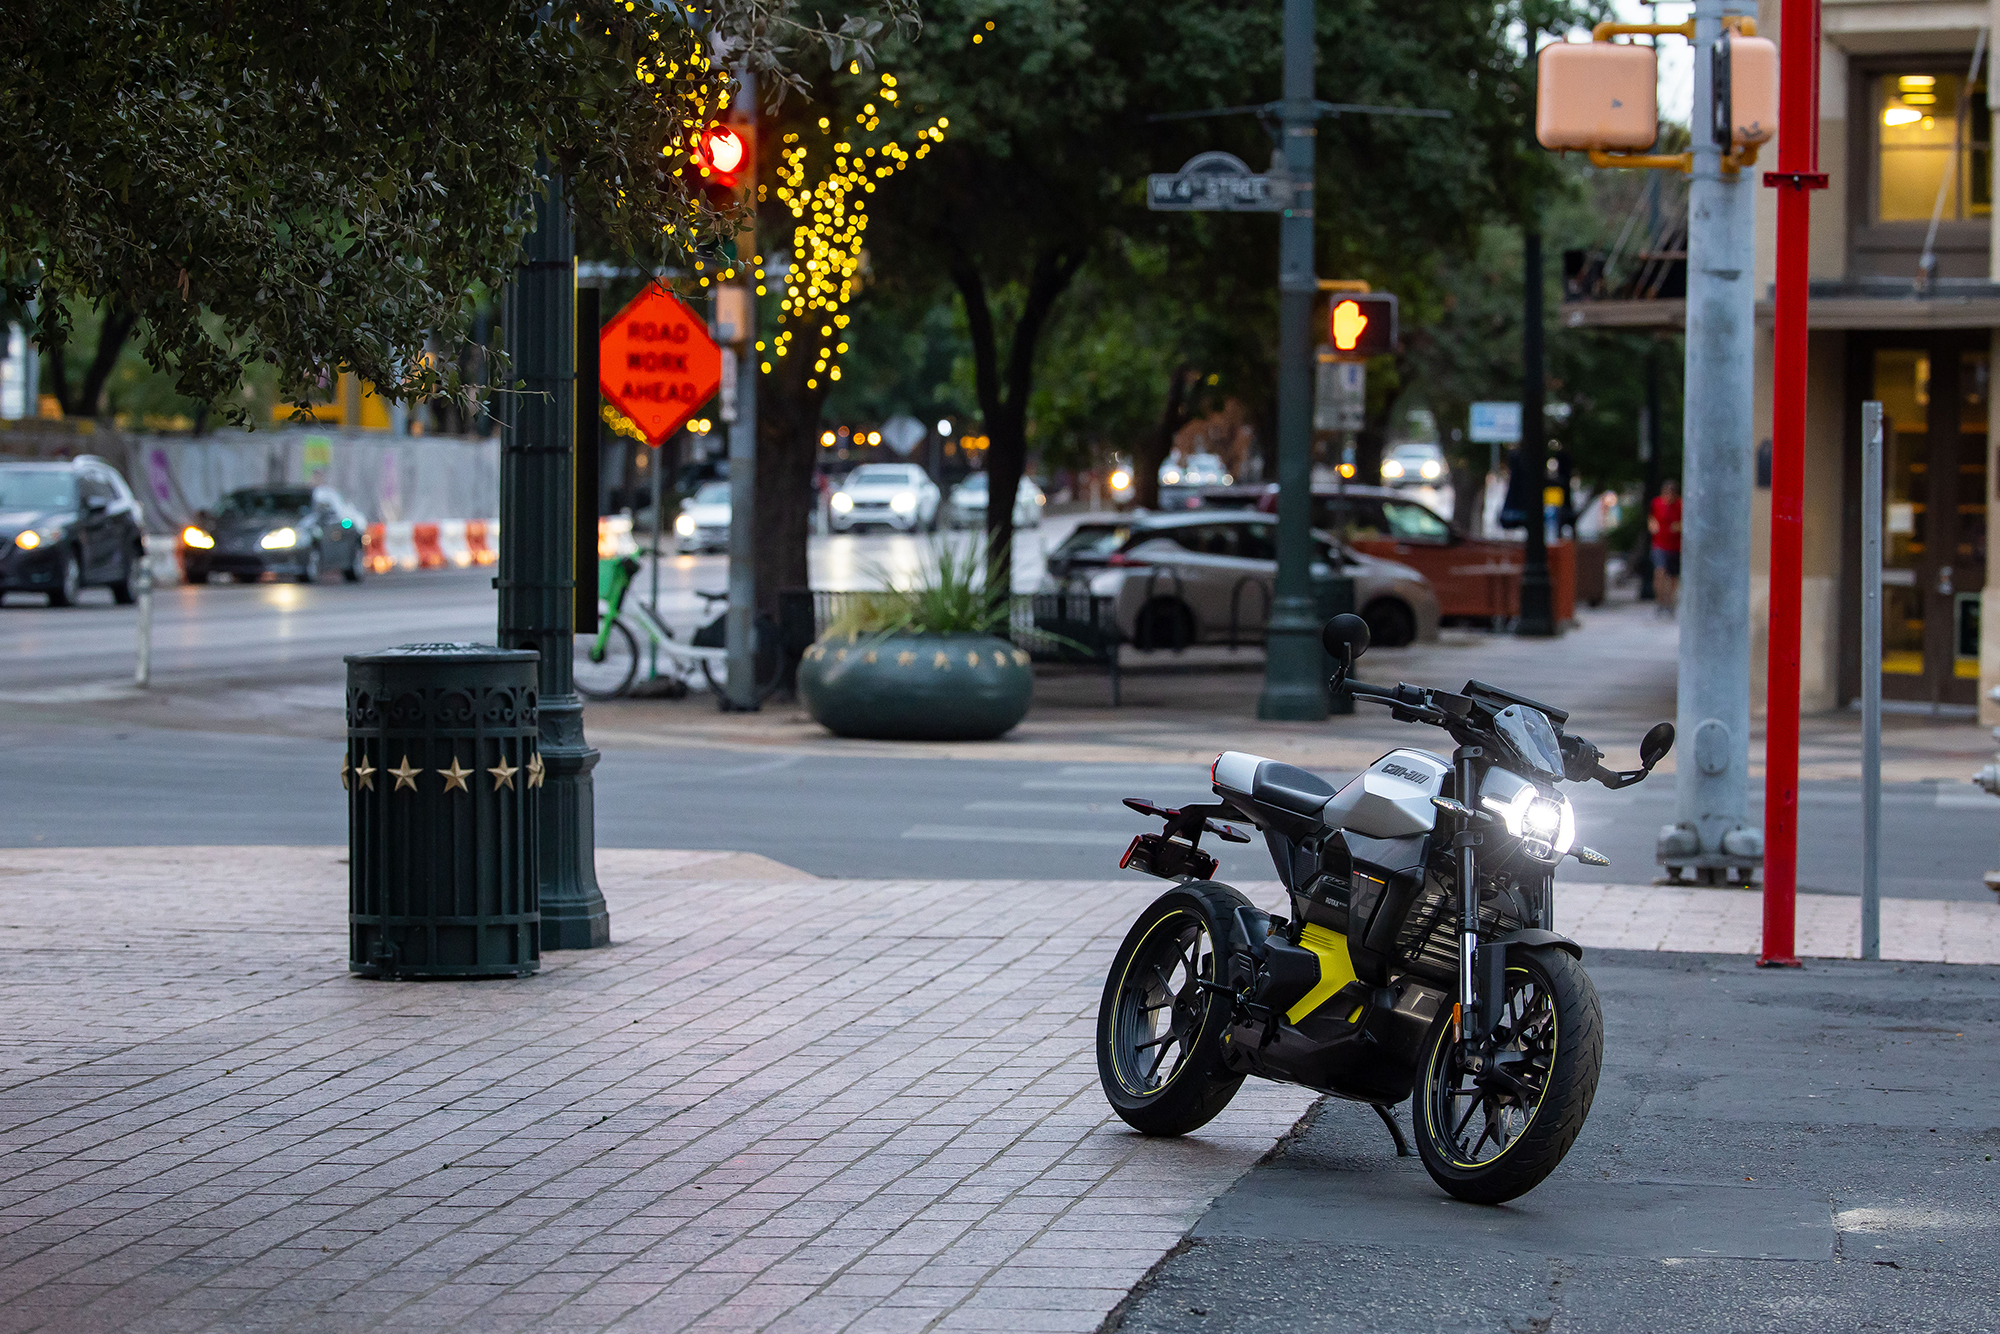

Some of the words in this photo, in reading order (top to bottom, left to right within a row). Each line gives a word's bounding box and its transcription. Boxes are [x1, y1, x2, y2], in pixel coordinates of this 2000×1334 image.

[627, 321, 690, 344] ROAD
[626, 352, 689, 373] WORK
[620, 382, 698, 404] AHEAD
[1381, 763, 1430, 785] can-am
